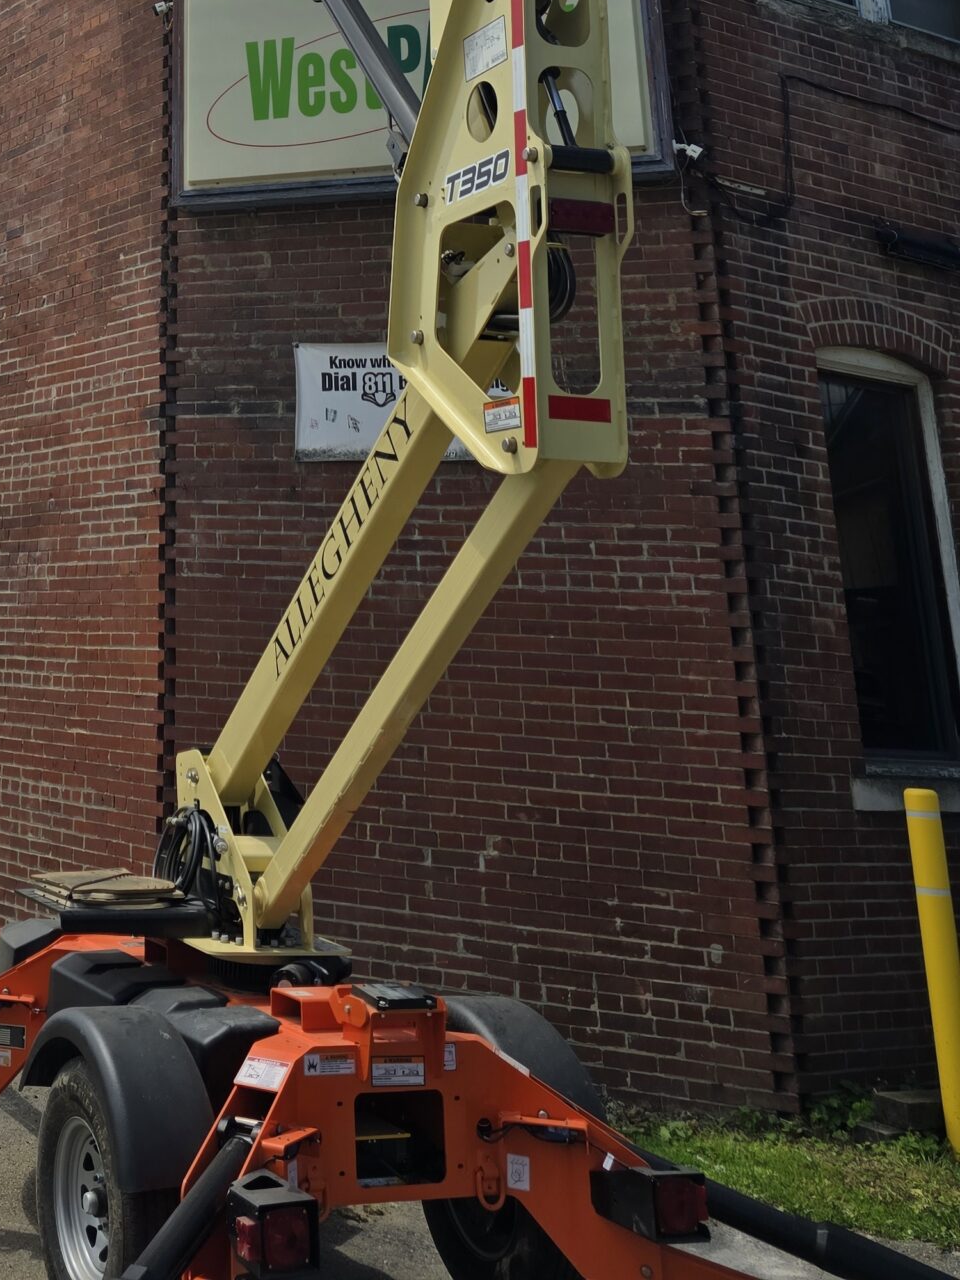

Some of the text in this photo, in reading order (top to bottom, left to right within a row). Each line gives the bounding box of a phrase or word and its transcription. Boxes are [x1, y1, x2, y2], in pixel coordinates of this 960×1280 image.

[447, 149, 510, 203] T350
[329, 355, 367, 369] Know
[321, 372, 357, 391] Dial
[362, 371, 393, 394] 811
[273, 397, 414, 681] ALLEGHENY
